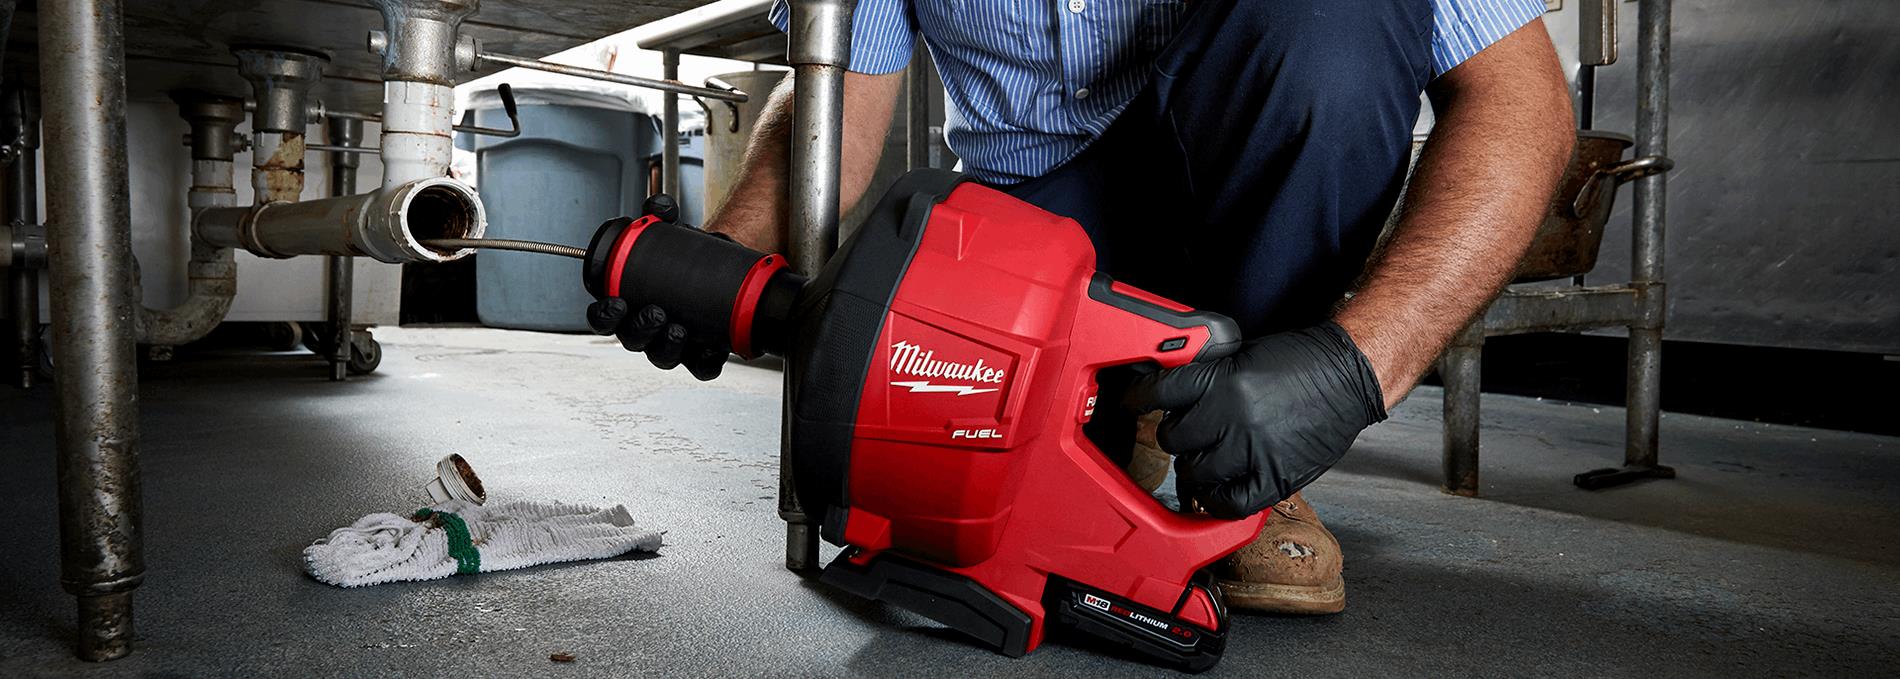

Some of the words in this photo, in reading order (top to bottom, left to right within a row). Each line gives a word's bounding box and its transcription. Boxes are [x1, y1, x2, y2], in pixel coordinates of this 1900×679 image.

[890, 340, 1004, 383] Milwaukee
[952, 429, 1002, 439] FUEL
[1085, 595, 1110, 610] M18
[1171, 626, 1193, 638] 2.0
